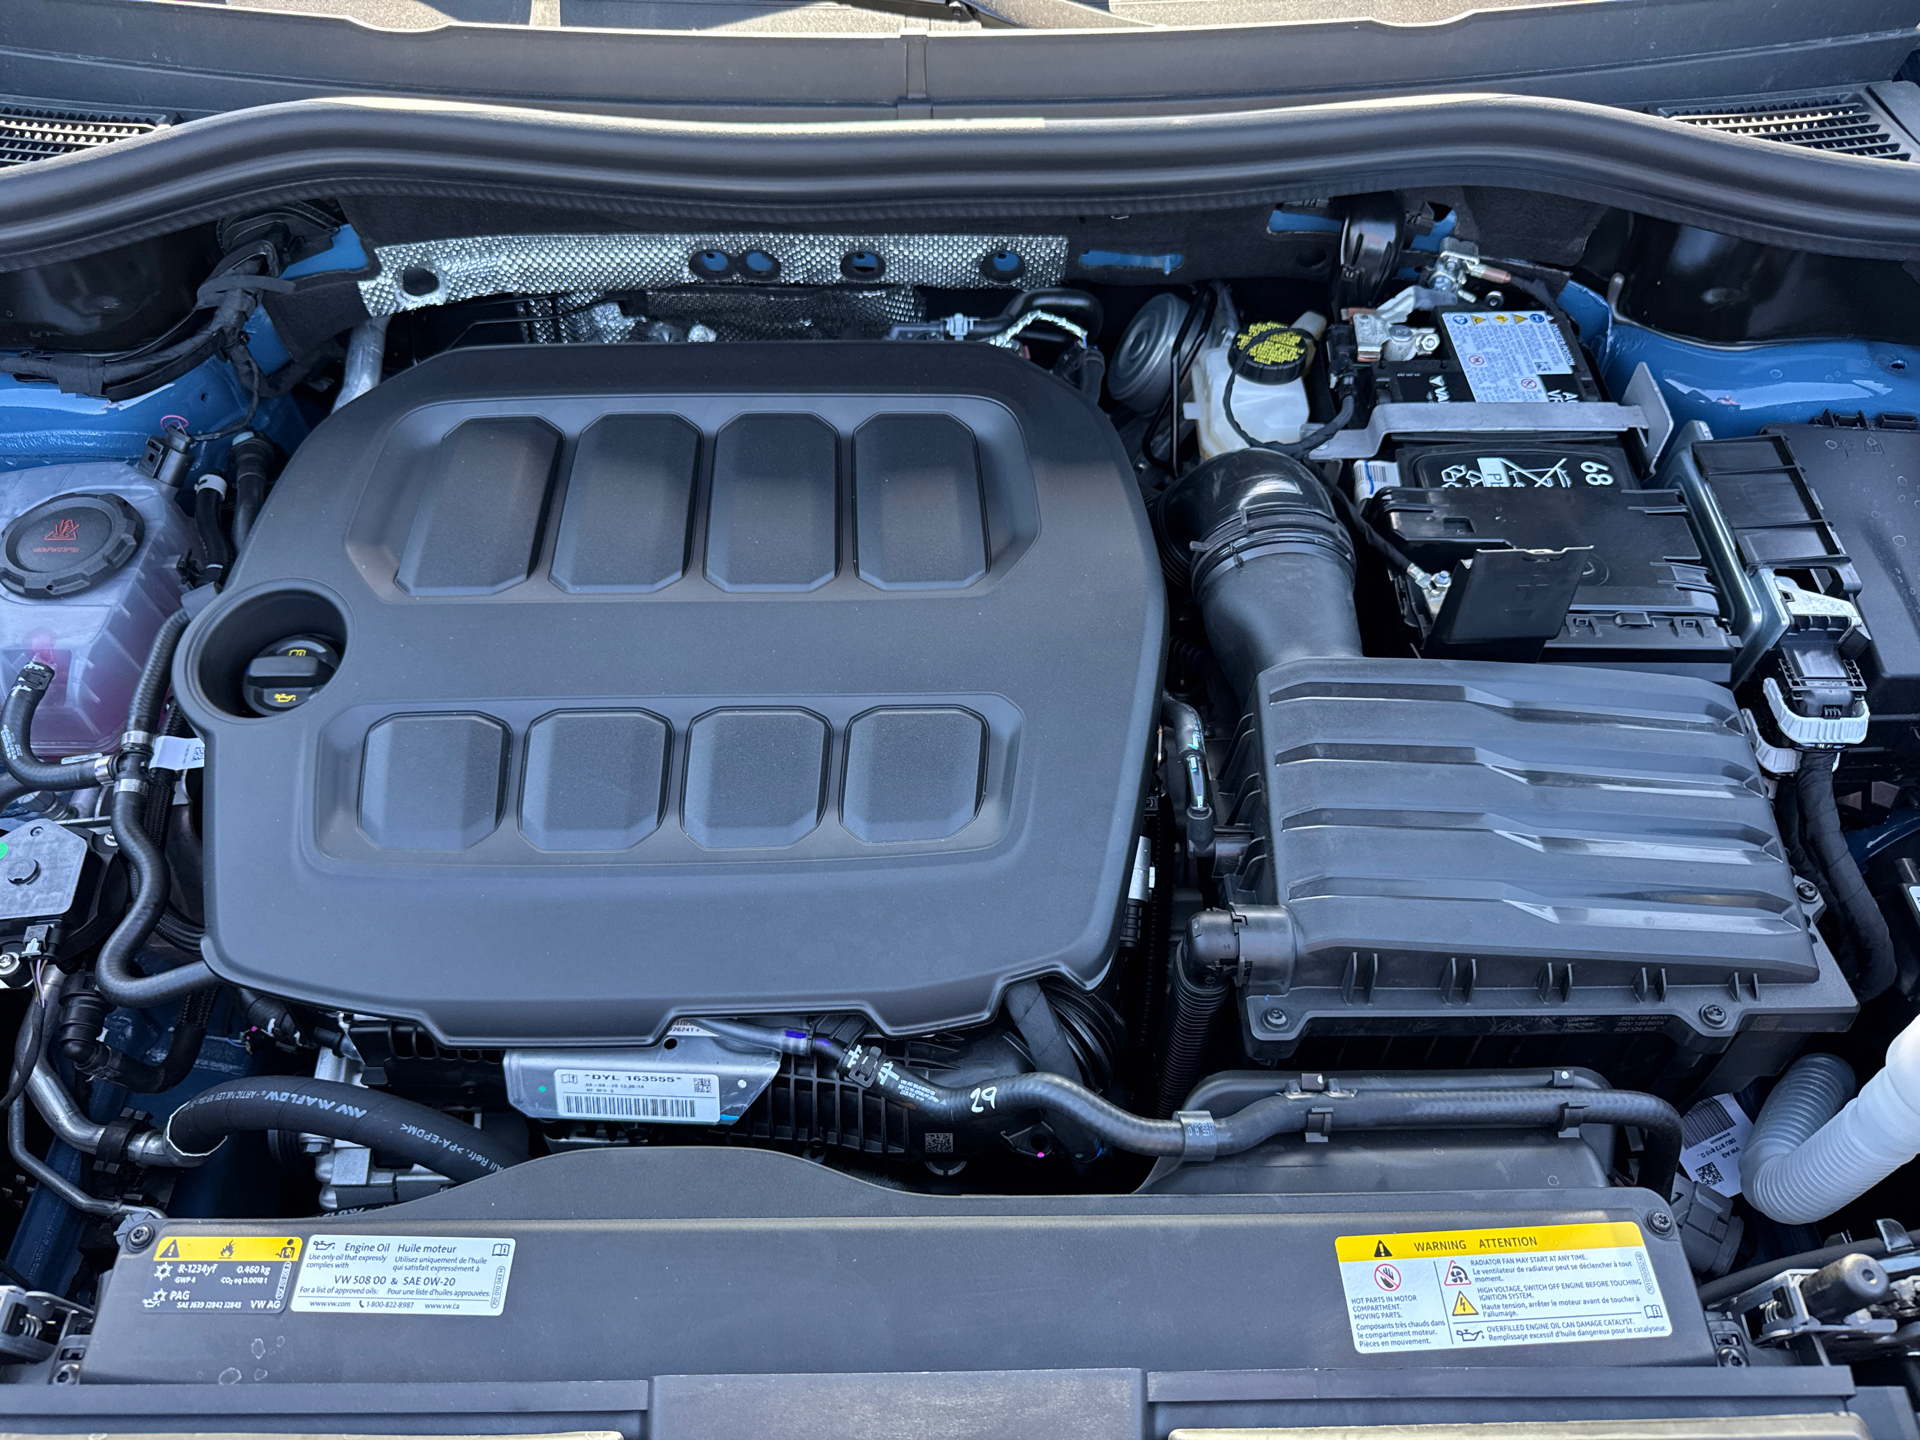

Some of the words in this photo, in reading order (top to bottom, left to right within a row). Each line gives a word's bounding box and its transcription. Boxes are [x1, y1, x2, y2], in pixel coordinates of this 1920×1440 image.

[1434, 385, 1450, 402] VA
[1580, 460, 1614, 486] 68
[970, 1086, 997, 1113] 29
[345, 1243, 375, 1254] Engine
[377, 1243, 390, 1252] Oil
[397, 1244, 421, 1252] Huile
[1414, 1240, 1466, 1252] WARNING
[1479, 1236, 1537, 1248] ATTENTION
[321, 1254, 335, 1262] only
[358, 1255, 387, 1263] expressly
[178, 1264, 218, 1276] R-1234yf
[236, 1266, 260, 1274] 0.460
[260, 1266, 271, 1276] kg
[334, 1275, 352, 1284] VW
[352, 1276, 371, 1285] 508
[373, 1276, 387, 1285] 00
[402, 1277, 421, 1285] SAE
[423, 1277, 456, 1286] 0W-20
[170, 1291, 190, 1300] PAG
[250, 1300, 268, 1309] VW
[267, 1300, 281, 1309] AG
[1352, 1304, 1402, 1312] COMPARTMENT.
[1356, 1322, 1394, 1332] Composants
[1603, 1318, 1635, 1326] CATALYST.
[1365, 1330, 1410, 1339] compartiment
[1488, 1333, 1529, 1342] Remplissage
[1577, 1328, 1610, 1337] dangereux
[1634, 1325, 1668, 1334] catalyseur.
[1390, 1338, 1431, 1346] mouvement.
